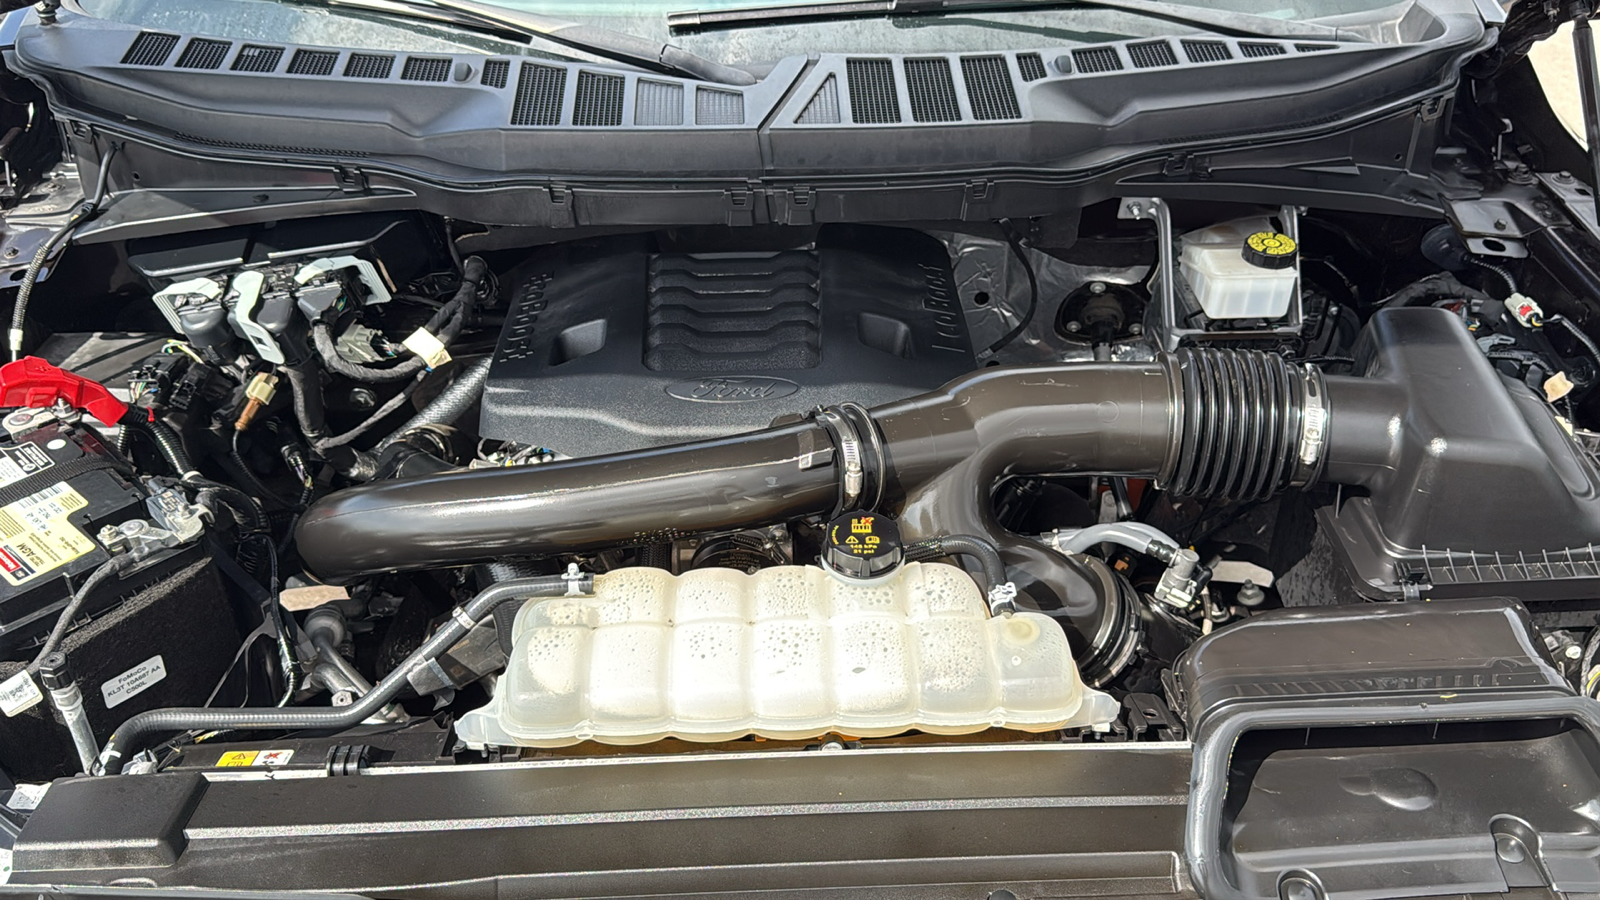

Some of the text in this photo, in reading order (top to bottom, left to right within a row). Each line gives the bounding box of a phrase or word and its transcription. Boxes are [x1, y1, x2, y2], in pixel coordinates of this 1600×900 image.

[691, 379, 776, 399] Ford
[16, 542, 36, 557] AGM
[107, 684, 125, 697] KL3T
[150, 665, 161, 674] AA
[118, 666, 147, 683] FoMoCo
